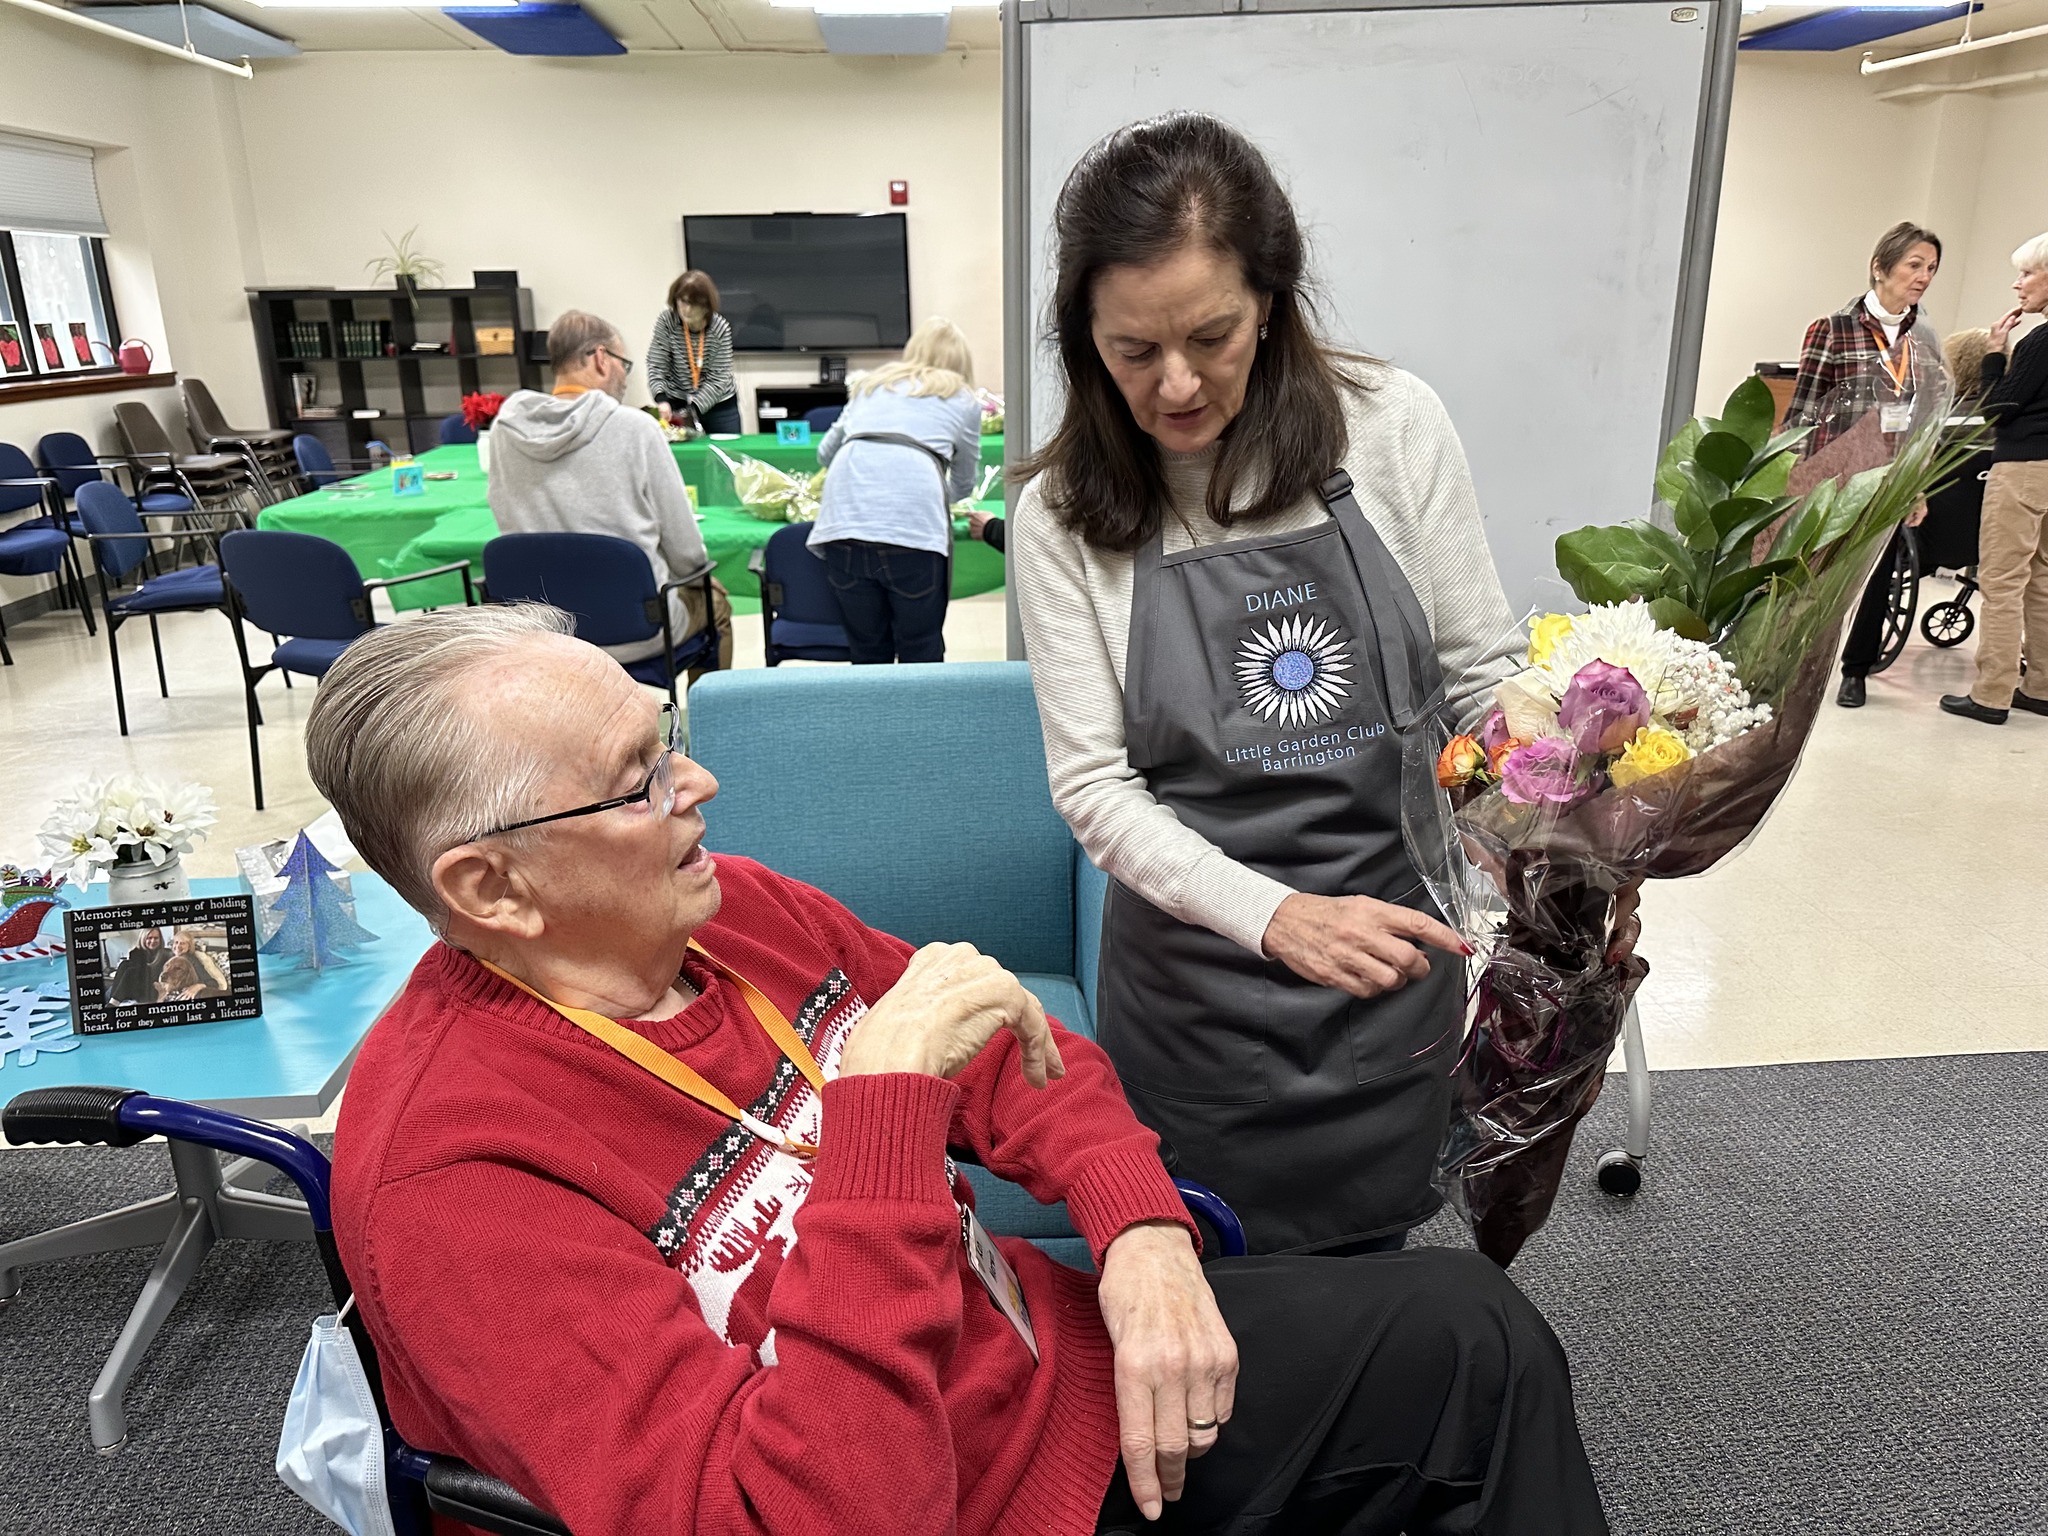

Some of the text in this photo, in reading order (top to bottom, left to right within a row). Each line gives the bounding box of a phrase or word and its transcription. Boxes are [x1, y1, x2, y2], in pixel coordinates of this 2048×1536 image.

[1245, 582, 1318, 612] DIANE
[1226, 722, 1385, 763] Little Garden Club
[1262, 746, 1355, 772] Barrington
[73, 907, 132, 921] Memories
[172, 904, 190, 913] way
[194, 901, 205, 910] of
[210, 898, 247, 910] holding
[74, 912, 247, 933] onto the things you love and treasure
[231, 925, 248, 935] feel
[75, 939, 98, 950] hugs
[80, 987, 101, 997] love
[234, 985, 256, 993] smiles
[80, 1003, 103, 1011] caring
[83, 997, 255, 1022] Keep fond memories in your
[84, 1022, 114, 1032] heart,
[116, 1020, 132, 1029] for
[138, 1019, 155, 1027] they
[162, 1016, 179, 1024] will
[187, 1013, 202, 1022] last
[221, 1007, 257, 1018] lifetime
